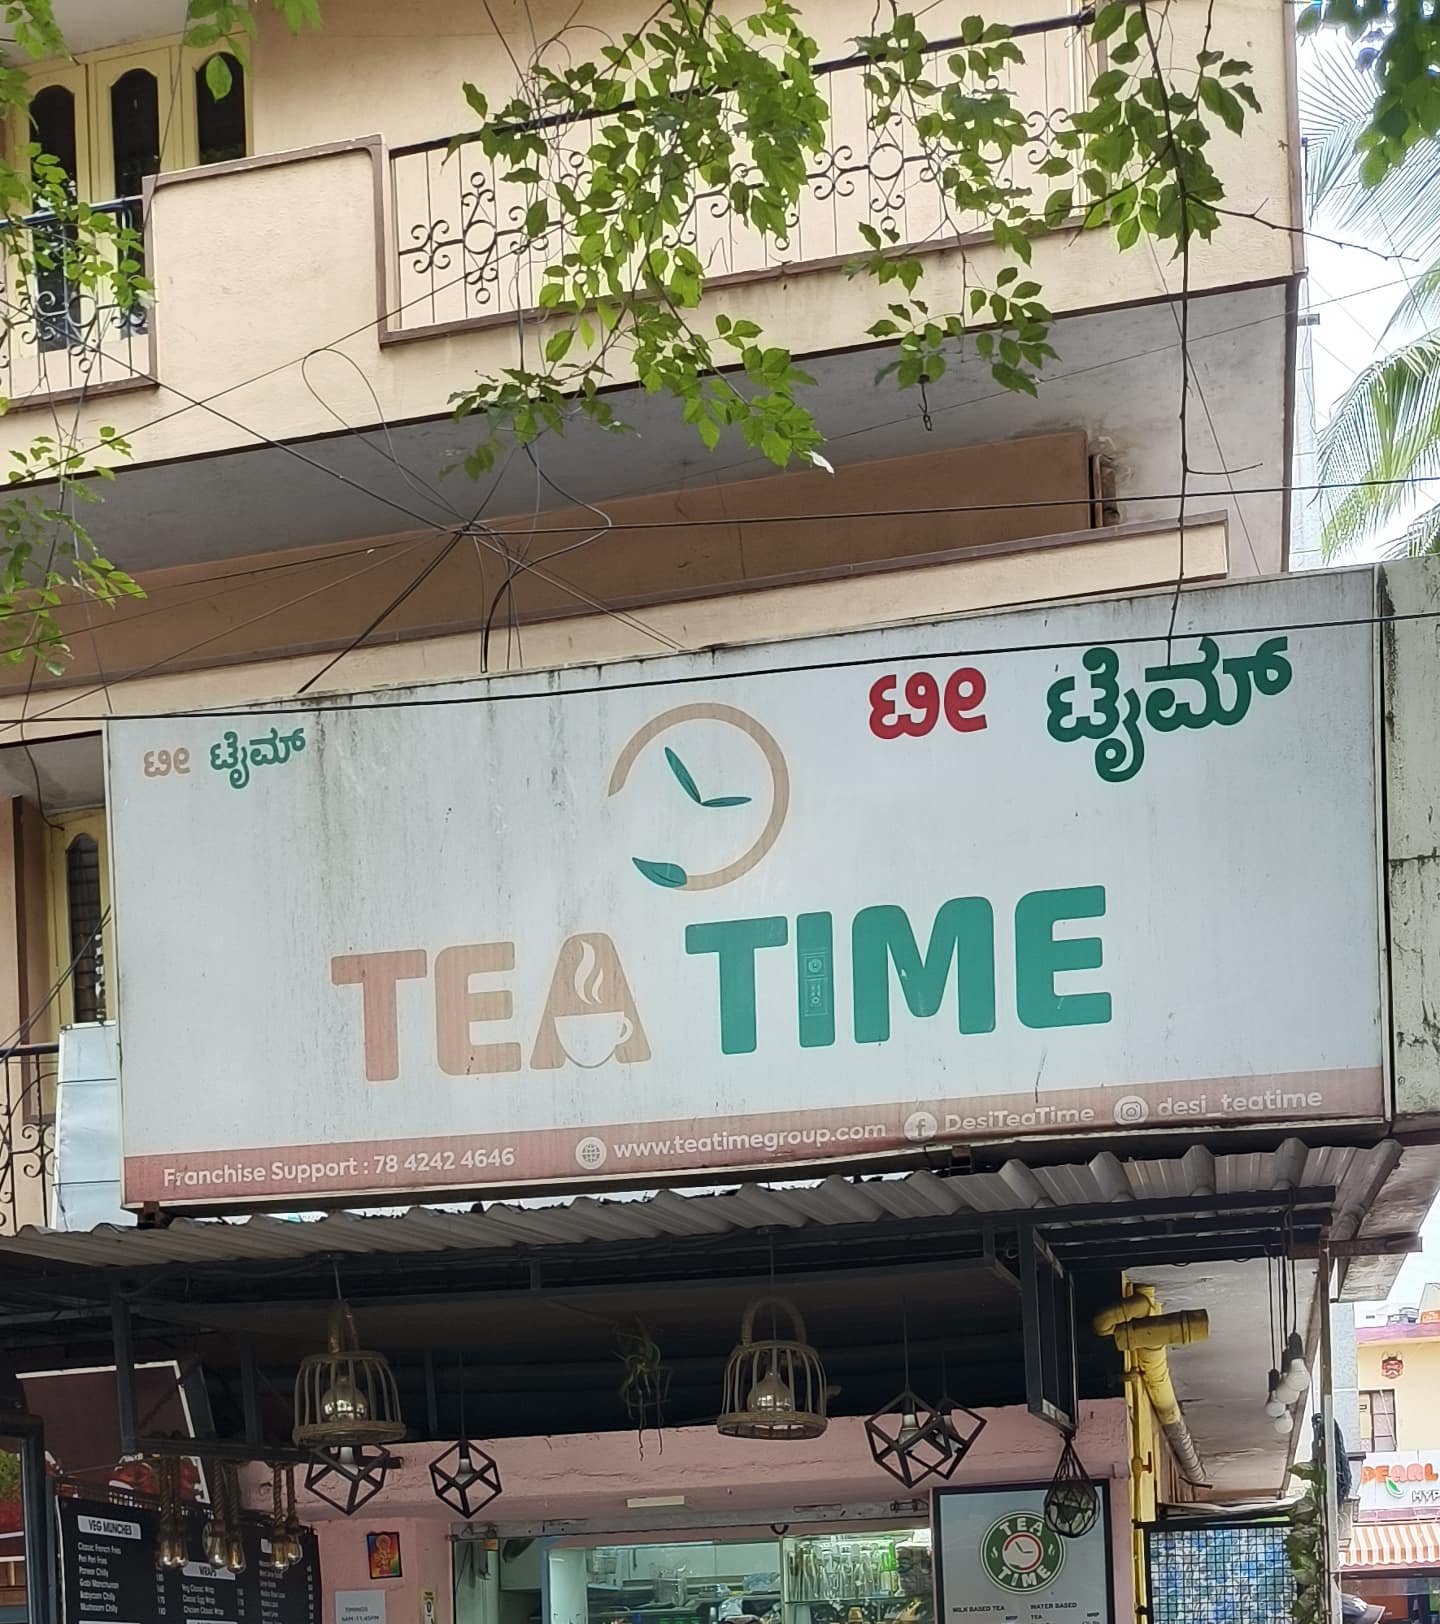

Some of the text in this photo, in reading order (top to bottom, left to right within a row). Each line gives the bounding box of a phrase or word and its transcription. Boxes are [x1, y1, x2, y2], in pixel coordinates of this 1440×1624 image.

[868, 636, 1292, 783] ಟೀ ಟೈಮ್
[143, 727, 306, 790] ಟೀ ಟೈಮ್
[330, 885, 1113, 1082] TEA TIME
[1156, 1088, 1323, 1118] desi_teatime
[944, 1106, 1096, 1132] DesiTeaTime
[613, 1122, 887, 1158] www.teatimegroup.com
[164, 1162, 266, 1188] Franchise
[271, 1157, 358, 1184] Support
[373, 1153, 398, 1174] 78
[403, 1151, 456, 1172] 4242
[460, 1148, 516, 1169] 4646
[1361, 1463, 1439, 1485] PEARL
[88, 1519, 132, 1535] VEG MUNCHES
[999, 1517, 1044, 1537] TEA
[998, 1565, 1051, 1587] TIME
